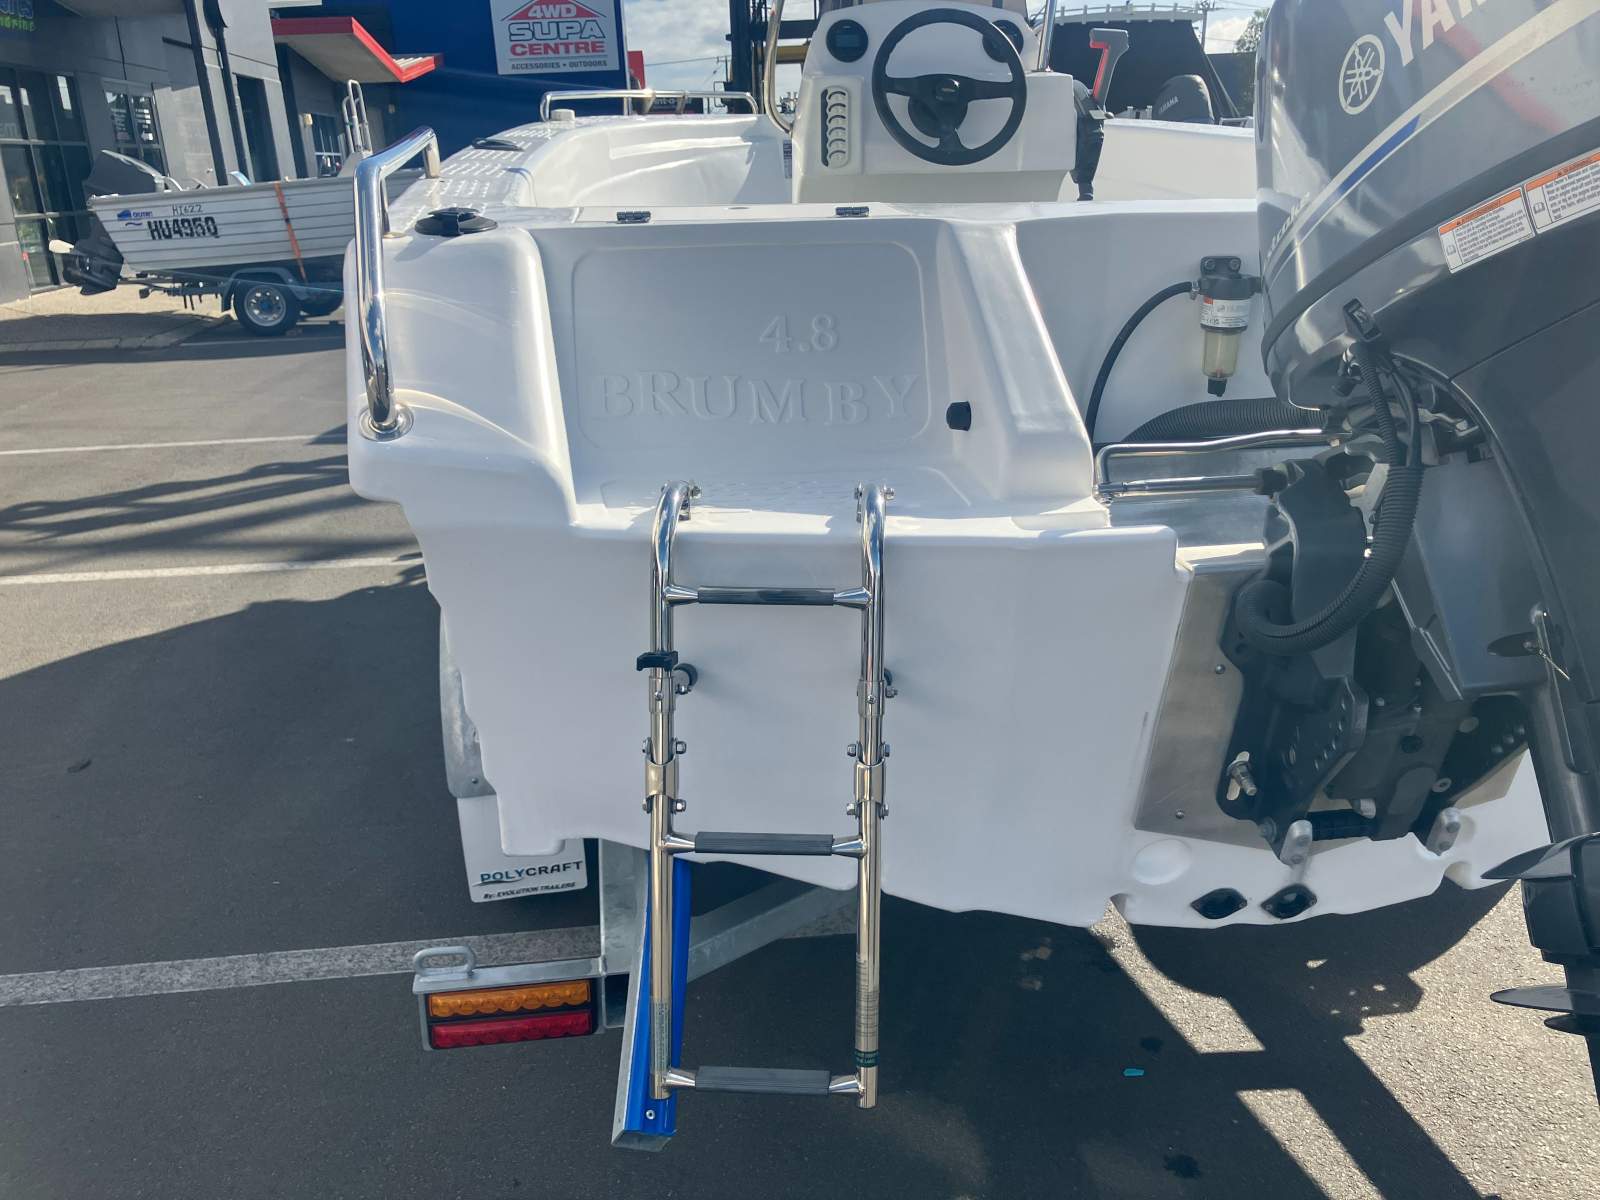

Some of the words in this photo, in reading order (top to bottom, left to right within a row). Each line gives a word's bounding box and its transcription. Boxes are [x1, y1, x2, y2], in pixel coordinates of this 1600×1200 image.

[528, 3, 577, 19] 4WD
[508, 20, 606, 41] SUPA
[510, 41, 606, 57] CENTRE
[511, 61, 561, 71] ACCESSORIES
[568, 60, 608, 69] OUTDOORS
[759, 312, 840, 353] 4.8
[600, 369, 920, 427] BRUMBY
[480, 860, 583, 883] POLYCRAFT
[497, 885, 539, 898] EVOLUTION
[540, 881, 576, 892] TRAILERS
